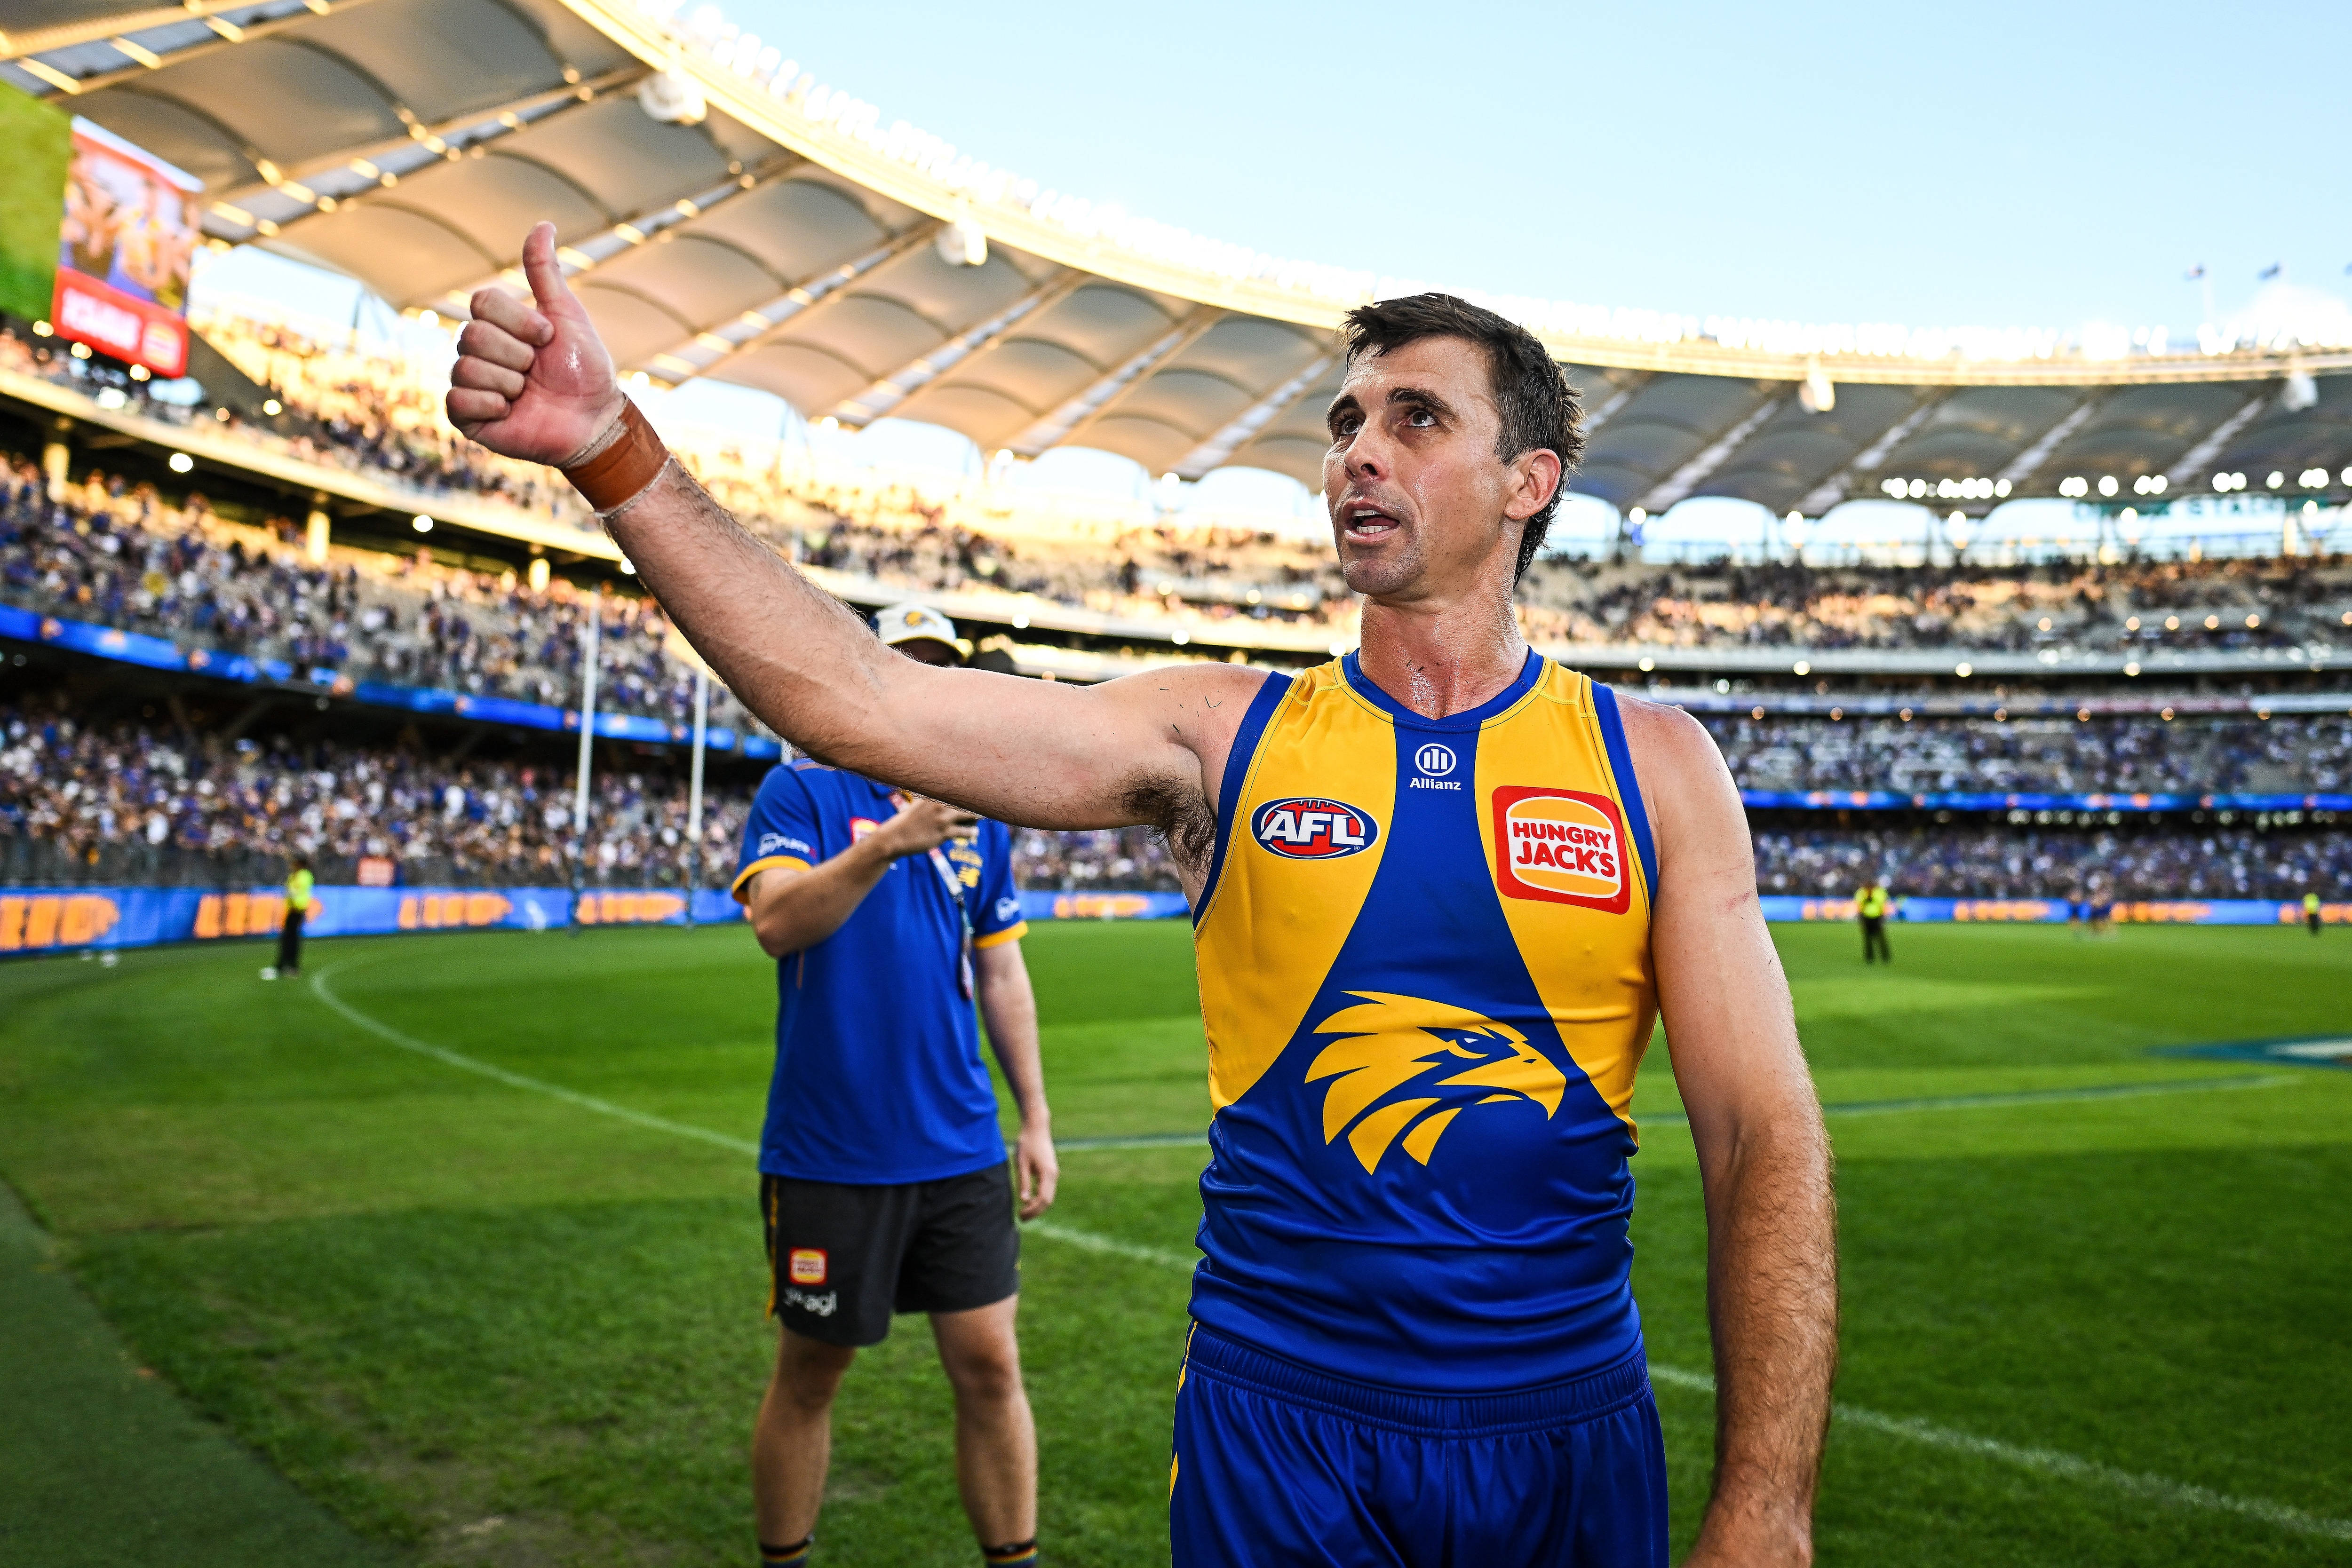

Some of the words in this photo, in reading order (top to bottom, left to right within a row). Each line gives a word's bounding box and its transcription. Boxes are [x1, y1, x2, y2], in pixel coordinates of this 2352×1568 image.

[1409, 777, 1461, 790] Allianz
[1260, 809, 1365, 846] AFL
[1512, 822, 1611, 849] HUNGRY
[1516, 841, 1615, 877] JACK'S
